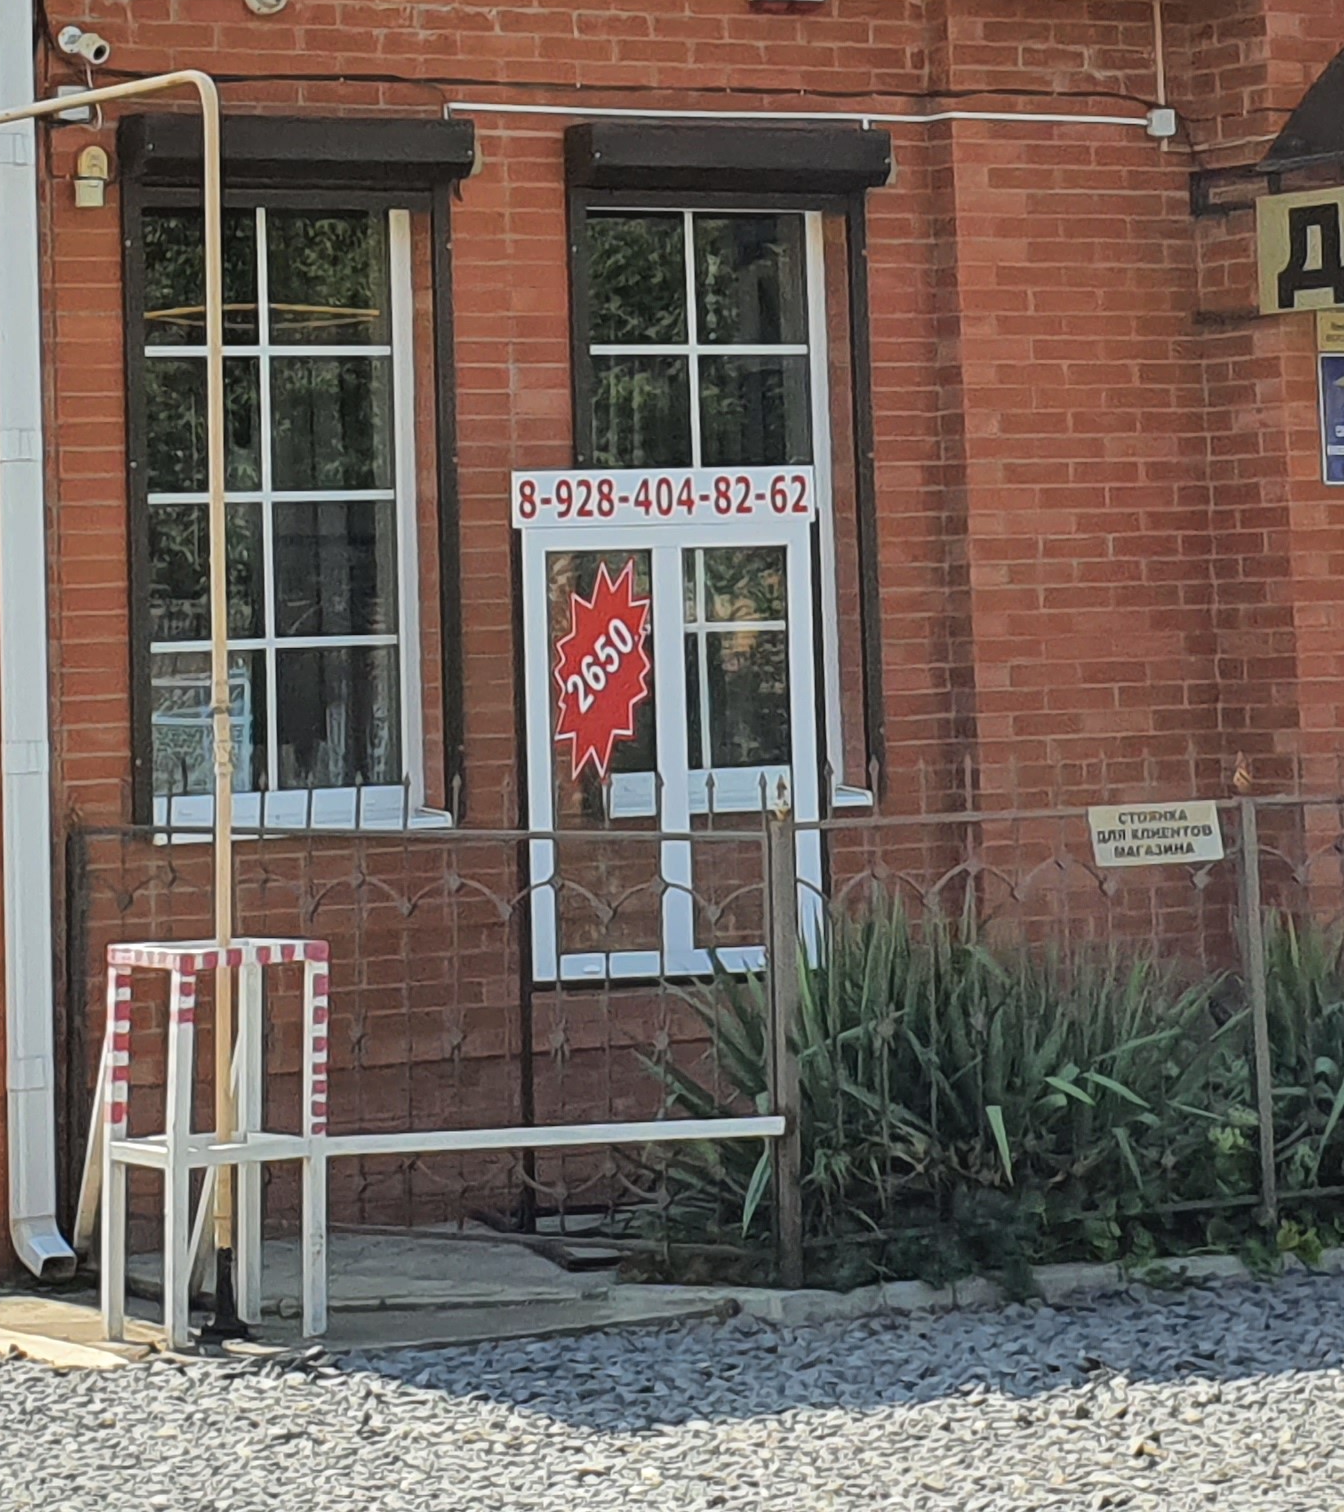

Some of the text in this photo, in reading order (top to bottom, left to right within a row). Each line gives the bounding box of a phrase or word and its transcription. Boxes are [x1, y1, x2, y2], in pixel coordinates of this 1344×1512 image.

[519, 474, 809, 520] 8-928-404-82-62
[1118, 809, 1188, 825] СТОЯНКА
[1097, 829, 1126, 844] ДЛЯ
[1114, 842, 1195, 858] МАГАЗИНА
